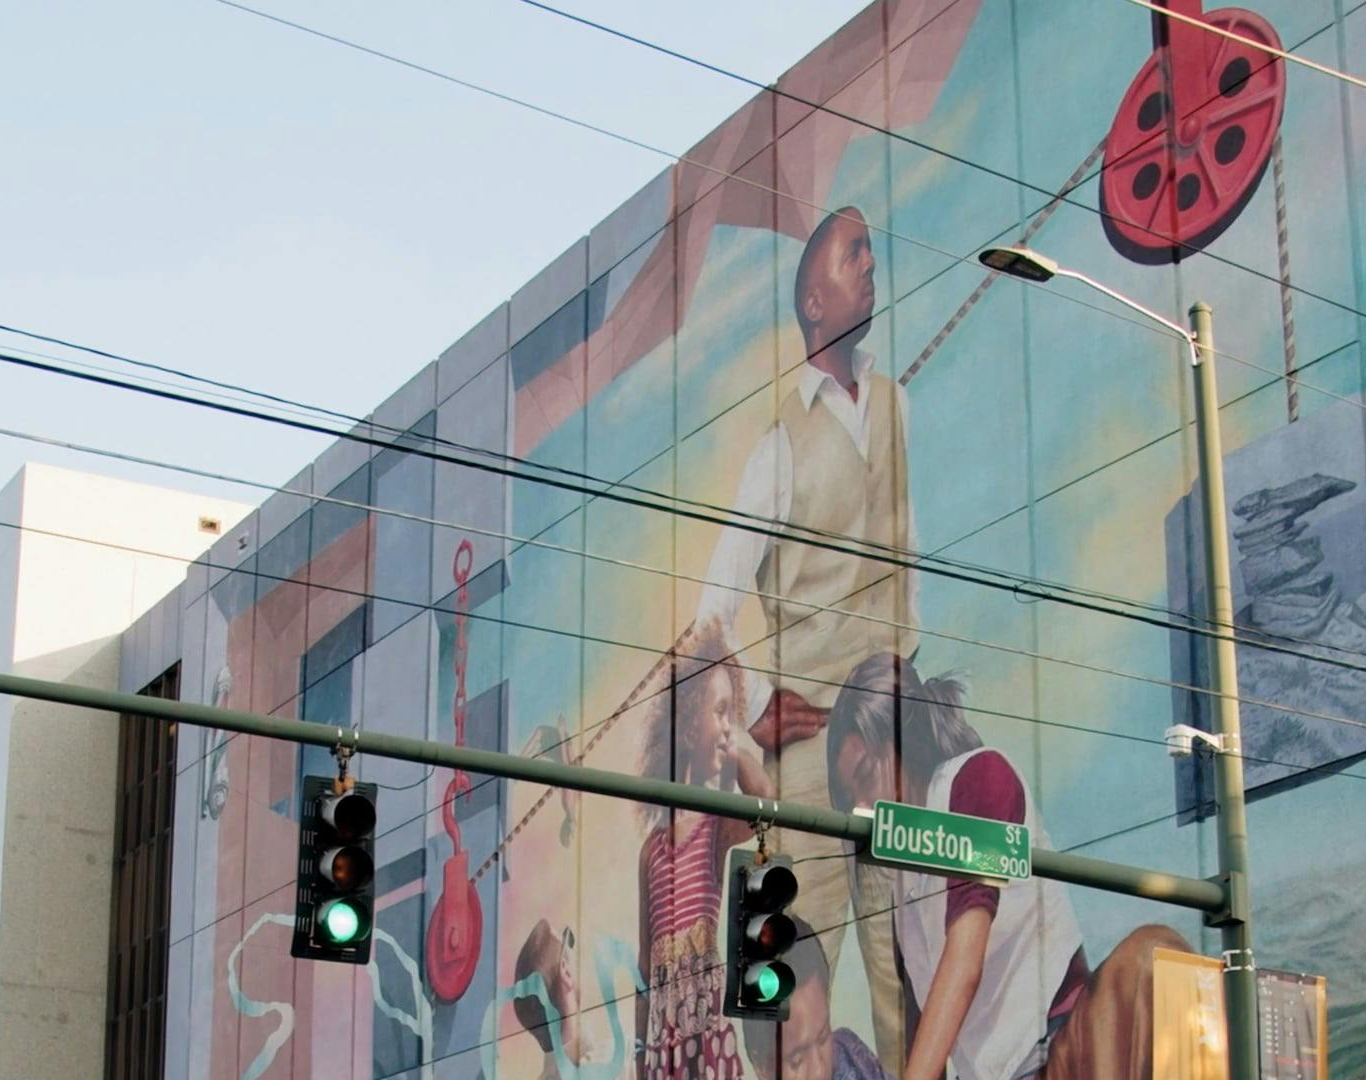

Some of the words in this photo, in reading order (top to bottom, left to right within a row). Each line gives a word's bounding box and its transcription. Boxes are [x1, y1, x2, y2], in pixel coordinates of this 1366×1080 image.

[876, 807, 973, 864] Houston
[1005, 825, 1022, 846] St
[999, 856, 1028, 878] 900
